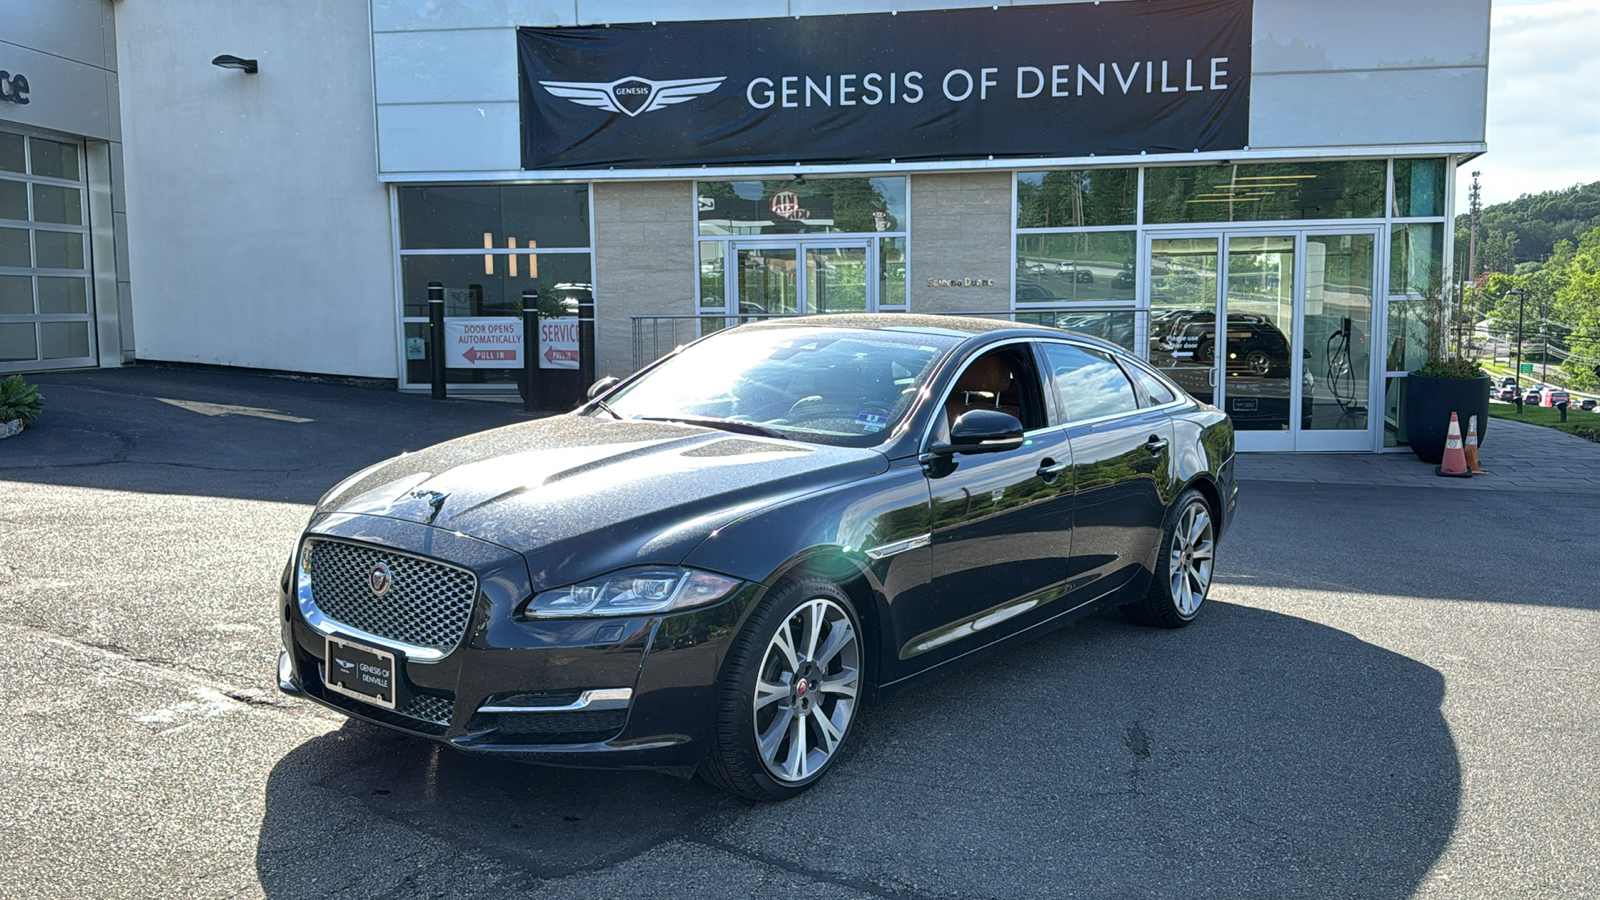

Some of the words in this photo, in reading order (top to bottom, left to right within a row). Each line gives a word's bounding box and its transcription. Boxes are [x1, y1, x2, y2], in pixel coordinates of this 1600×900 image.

[746, 71, 924, 109] GENESIS
[942, 67, 998, 101] OF
[1017, 57, 1229, 99] DENVILLE
[616, 87, 649, 95] GENESIS
[964, 277, 993, 287] Duane
[464, 325, 486, 333] DOOR
[488, 325, 514, 333] OPENS
[458, 335, 521, 344] AUTOMATICALLY
[476, 351, 495, 359] PULL
[497, 351, 505, 359] IN
[359, 663, 381, 675] GENESIS
[381, 669, 390, 678] OF
[362, 673, 388, 687] DENVILLE
